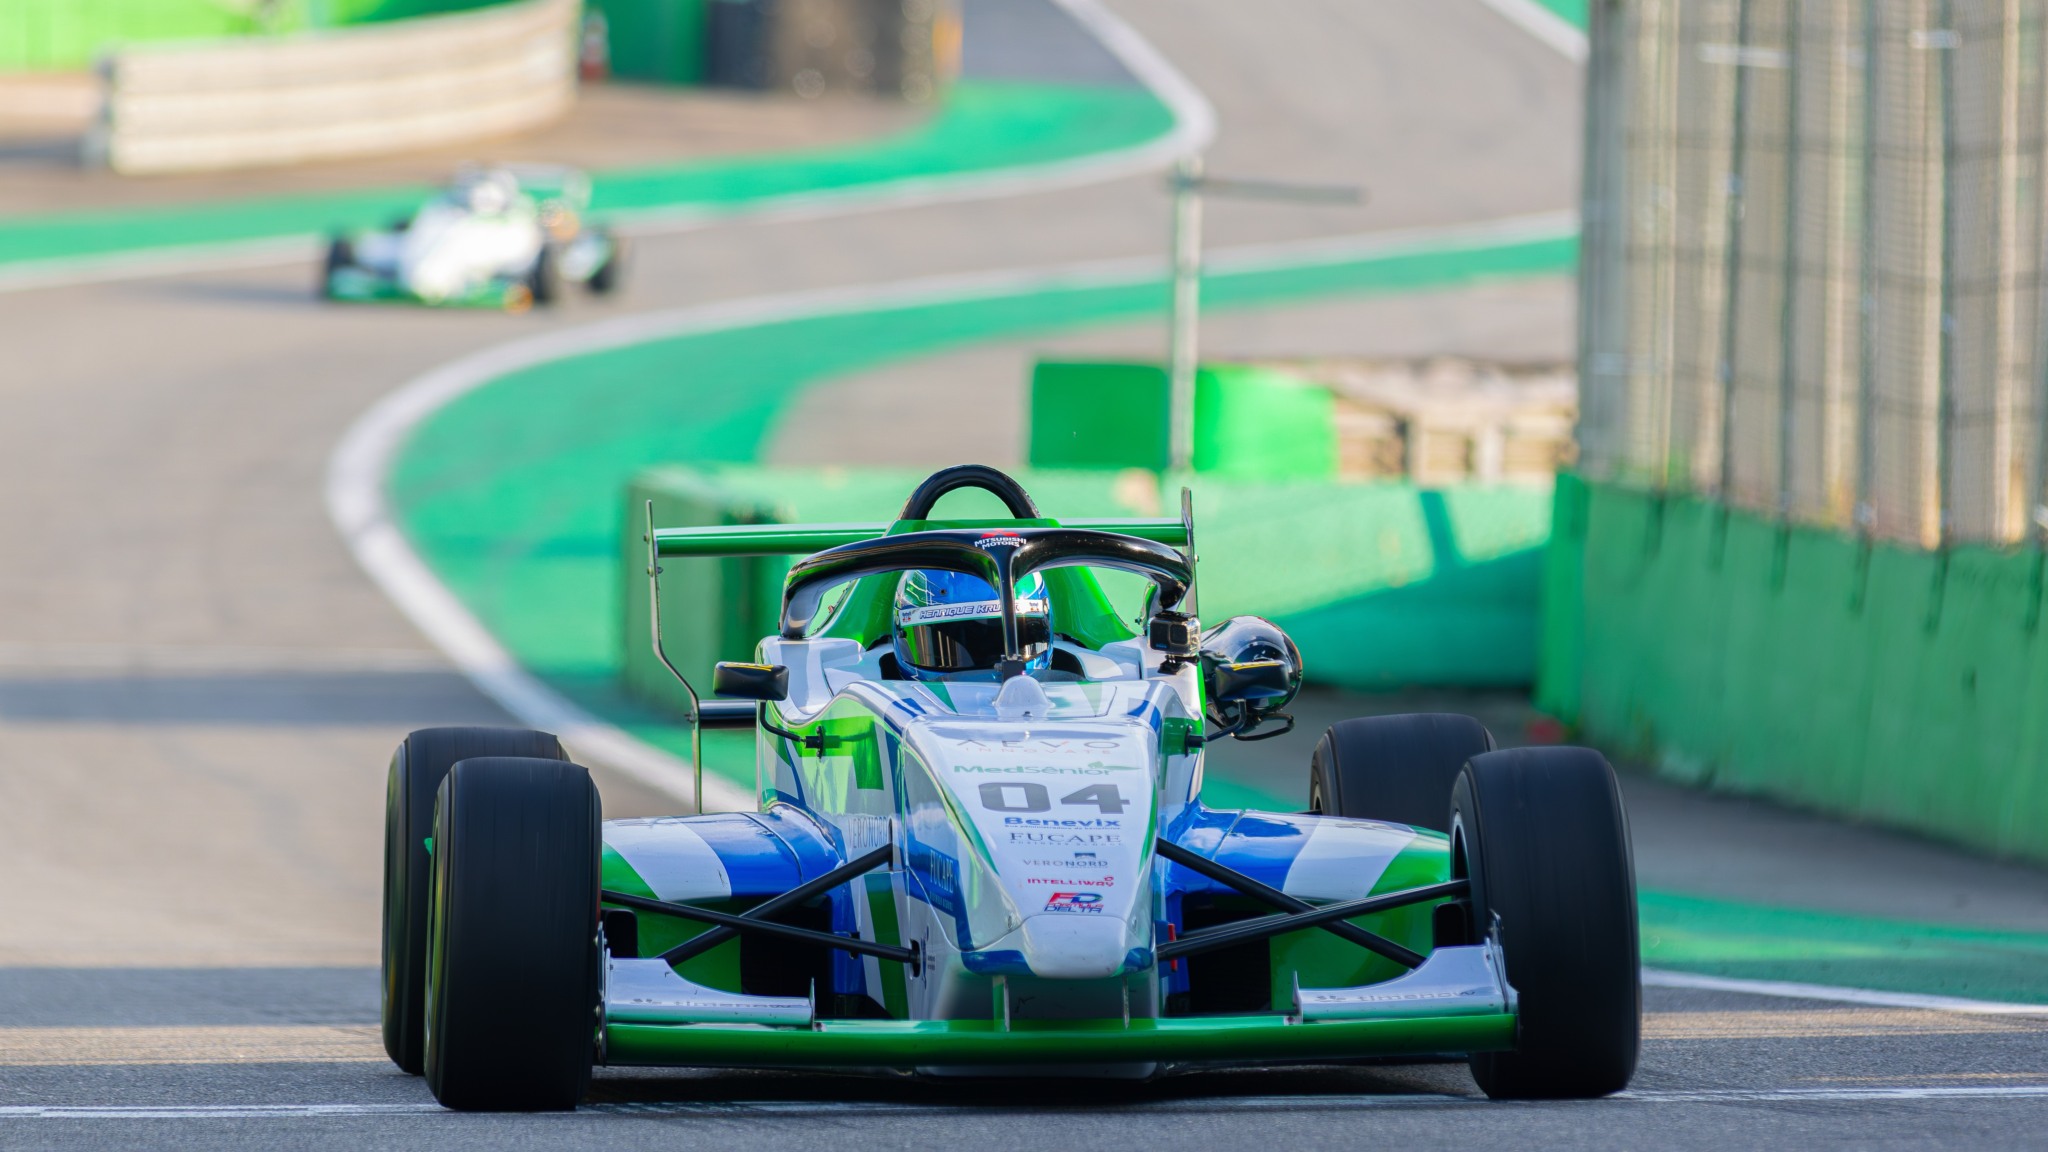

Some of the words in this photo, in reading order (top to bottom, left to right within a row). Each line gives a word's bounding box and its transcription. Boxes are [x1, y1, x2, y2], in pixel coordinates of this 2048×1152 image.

[974, 537, 1027, 547] MITSUBISHI
[981, 541, 1020, 550] MOTORS
[919, 605, 974, 619] HENRIQUE
[953, 765, 1115, 776] MedSênior
[978, 782, 1131, 815] 04
[1003, 816, 1121, 828] Benevix
[1009, 832, 1121, 843] FUCAPE
[1043, 905, 1103, 913] DELTA
